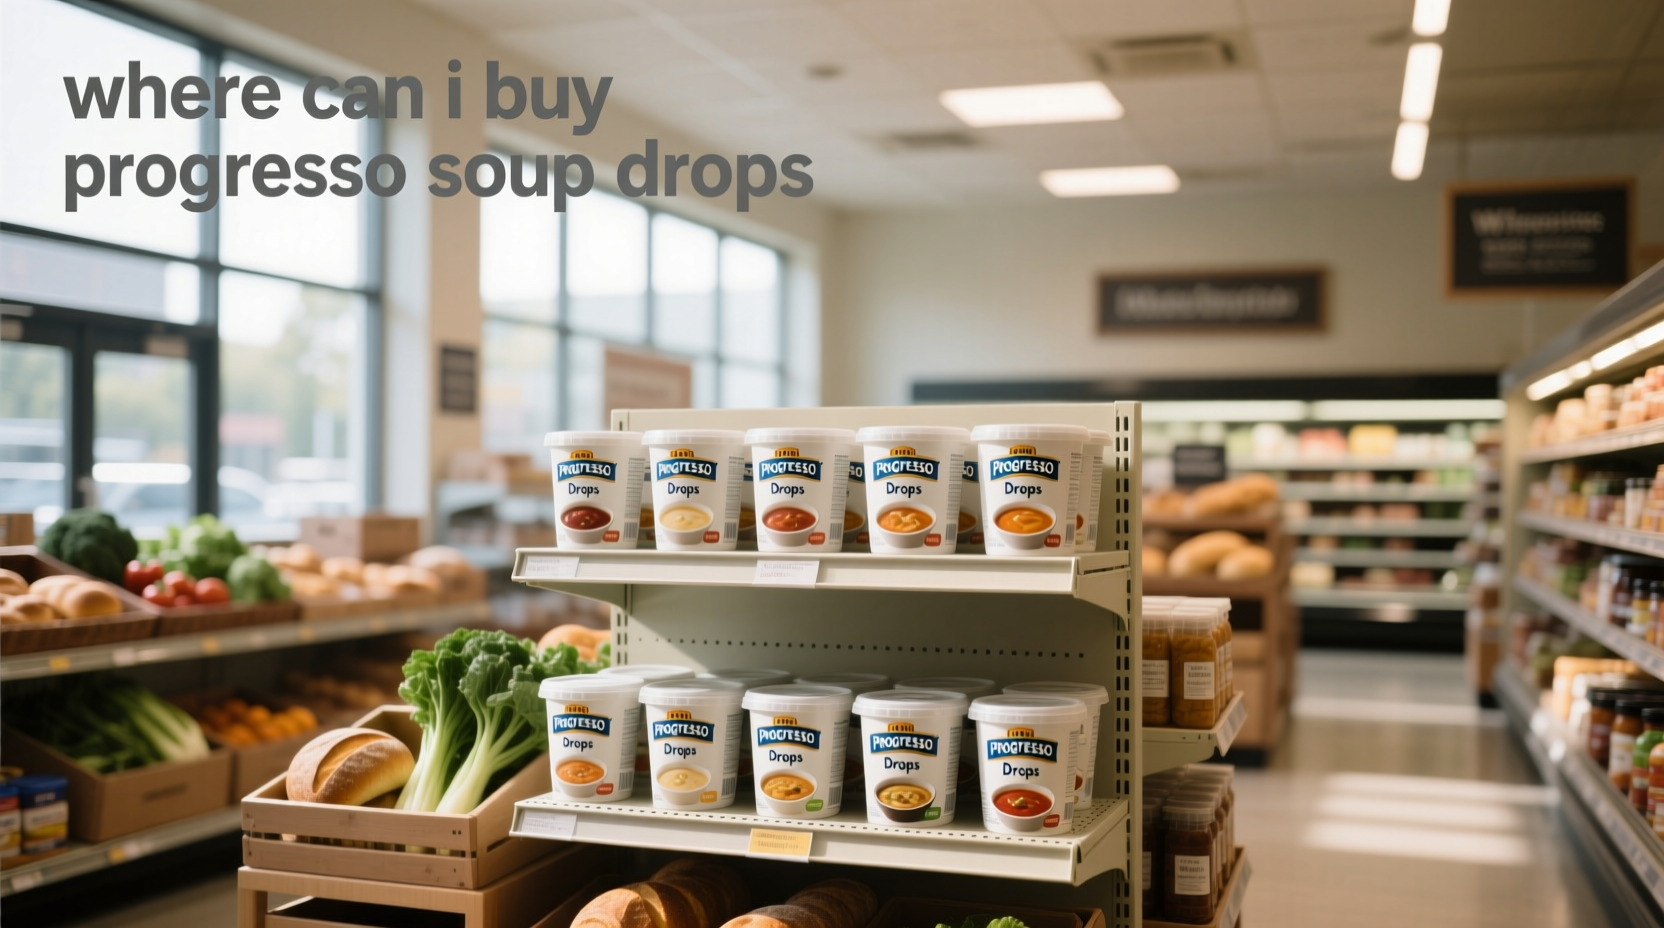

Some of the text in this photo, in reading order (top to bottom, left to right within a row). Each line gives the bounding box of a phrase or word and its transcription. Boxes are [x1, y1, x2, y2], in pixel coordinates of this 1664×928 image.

[568, 482, 600, 498] Drops
[667, 482, 700, 498] Drops
[771, 482, 805, 498] Drops
[886, 482, 922, 498] Drops
[1005, 482, 1042, 498] Drops
[563, 737, 594, 752] Drops
[664, 743, 697, 759] Drops
[769, 750, 803, 766] Drops
[884, 757, 920, 774] Drops
[1002, 763, 1040, 779] Drops
